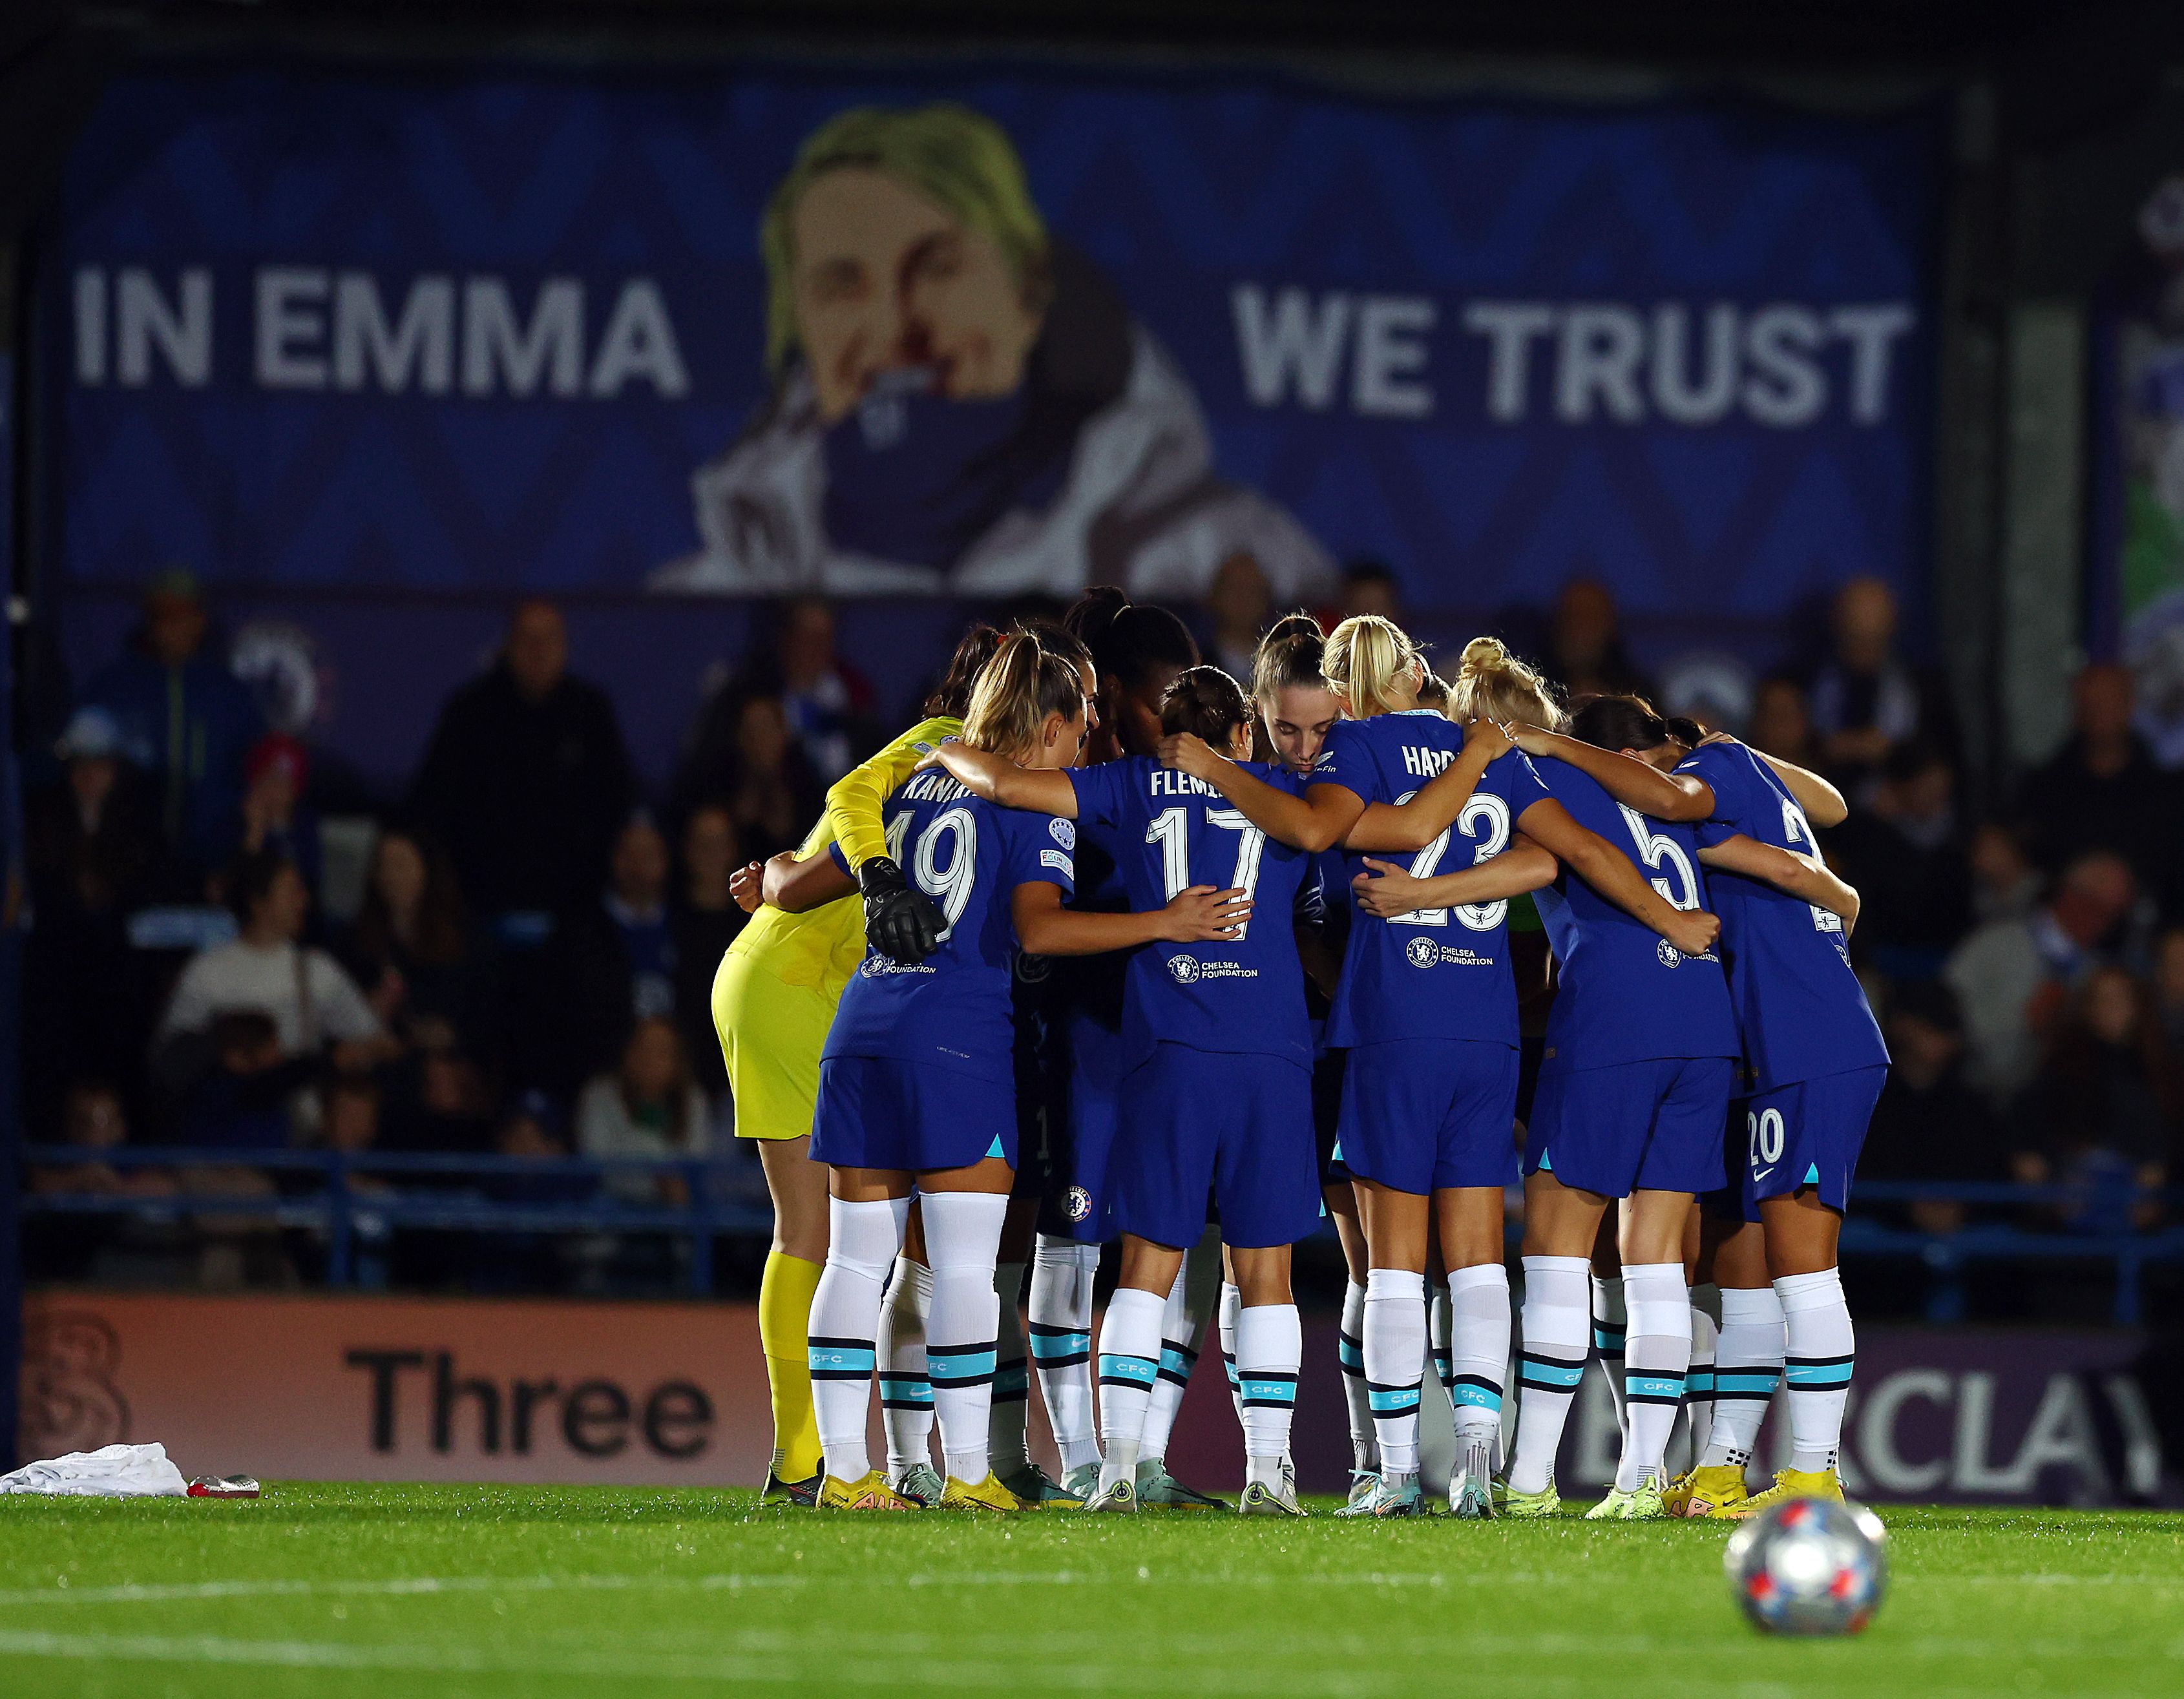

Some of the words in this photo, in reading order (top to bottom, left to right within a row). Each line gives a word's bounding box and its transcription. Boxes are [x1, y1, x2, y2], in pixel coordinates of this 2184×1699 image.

[73, 266, 215, 386] IN
[254, 266, 690, 397] EMMA
[1232, 286, 1435, 417] WE
[1463, 301, 1914, 425] TRUST
[1151, 771, 1223, 798] FLEMI
[1616, 801, 1701, 912] 5
[1146, 806, 1266, 941] 17
[1441, 946, 1475, 957] CHELSEA
[1441, 955, 1493, 965] FOUNDATION
[1202, 969, 1257, 979] FOUNDATION
[1748, 1108, 1785, 1166] 20
[814, 1354, 842, 1363] CFC
[930, 1362, 947, 1371] FC
[1116, 1364, 1148, 1375] CFC
[345, 1347, 713, 1457] Three
[1391, 1390, 1419, 1403] CFC
[1460, 1390, 1486, 1403] CFC
